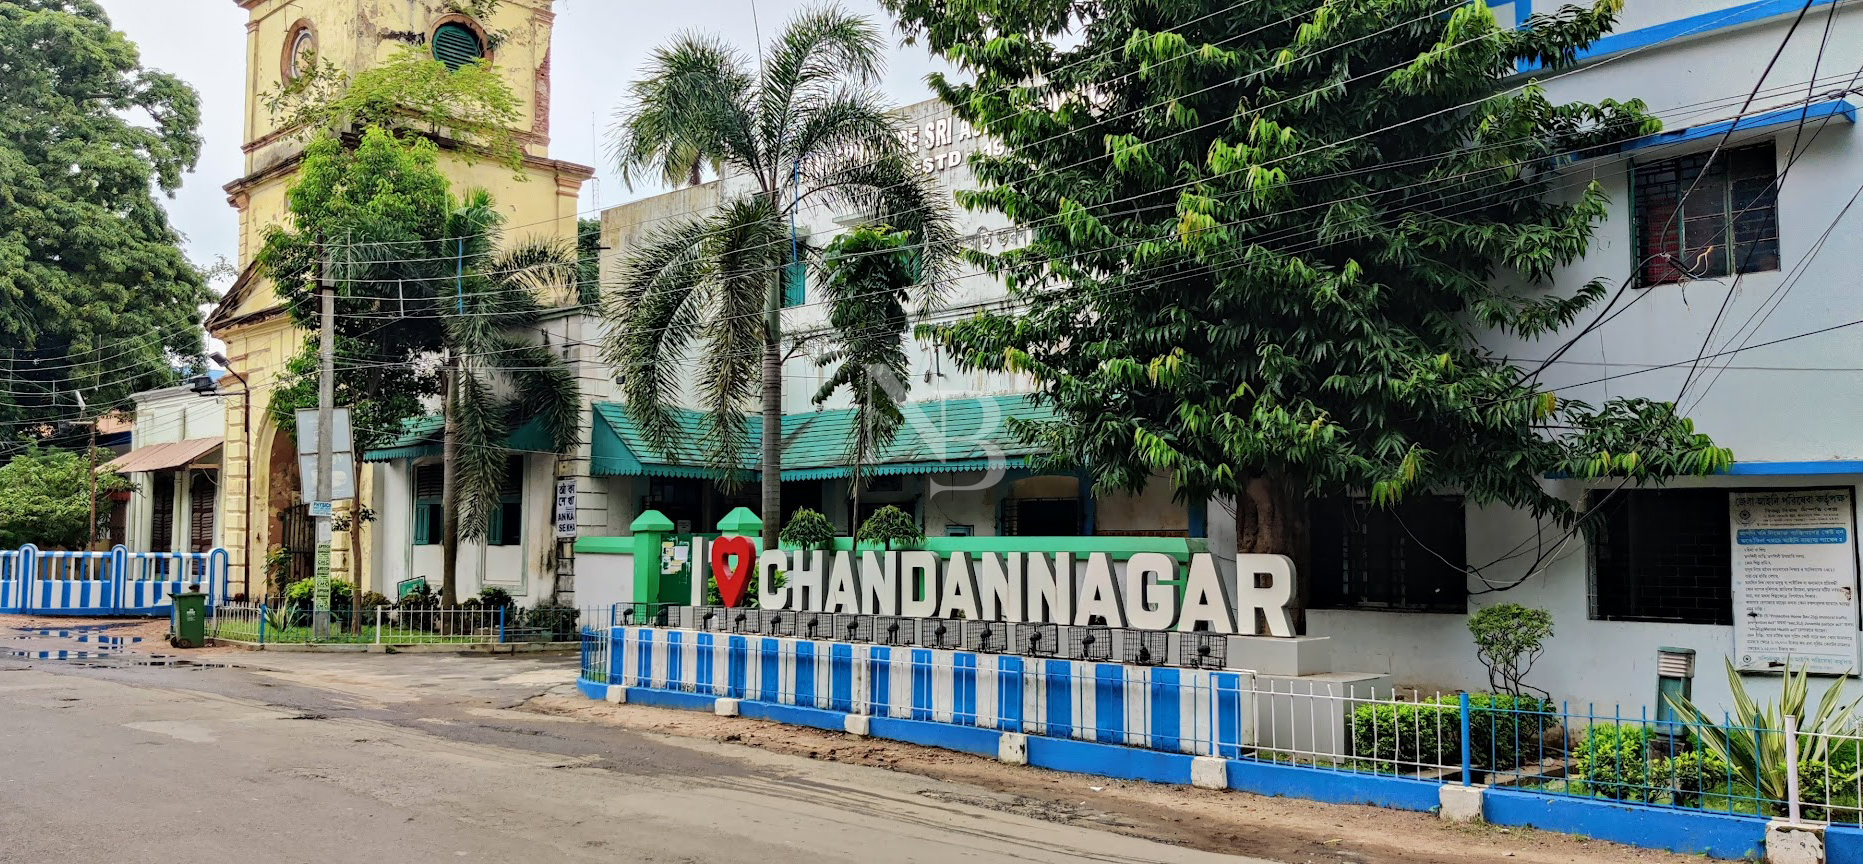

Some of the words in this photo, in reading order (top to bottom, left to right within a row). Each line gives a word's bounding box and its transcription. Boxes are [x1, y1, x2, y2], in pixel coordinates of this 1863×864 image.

[925, 117, 954, 150] SRI
[691, 536, 703, 606] I
[759, 549, 1296, 638] CHANDANNAGAR
